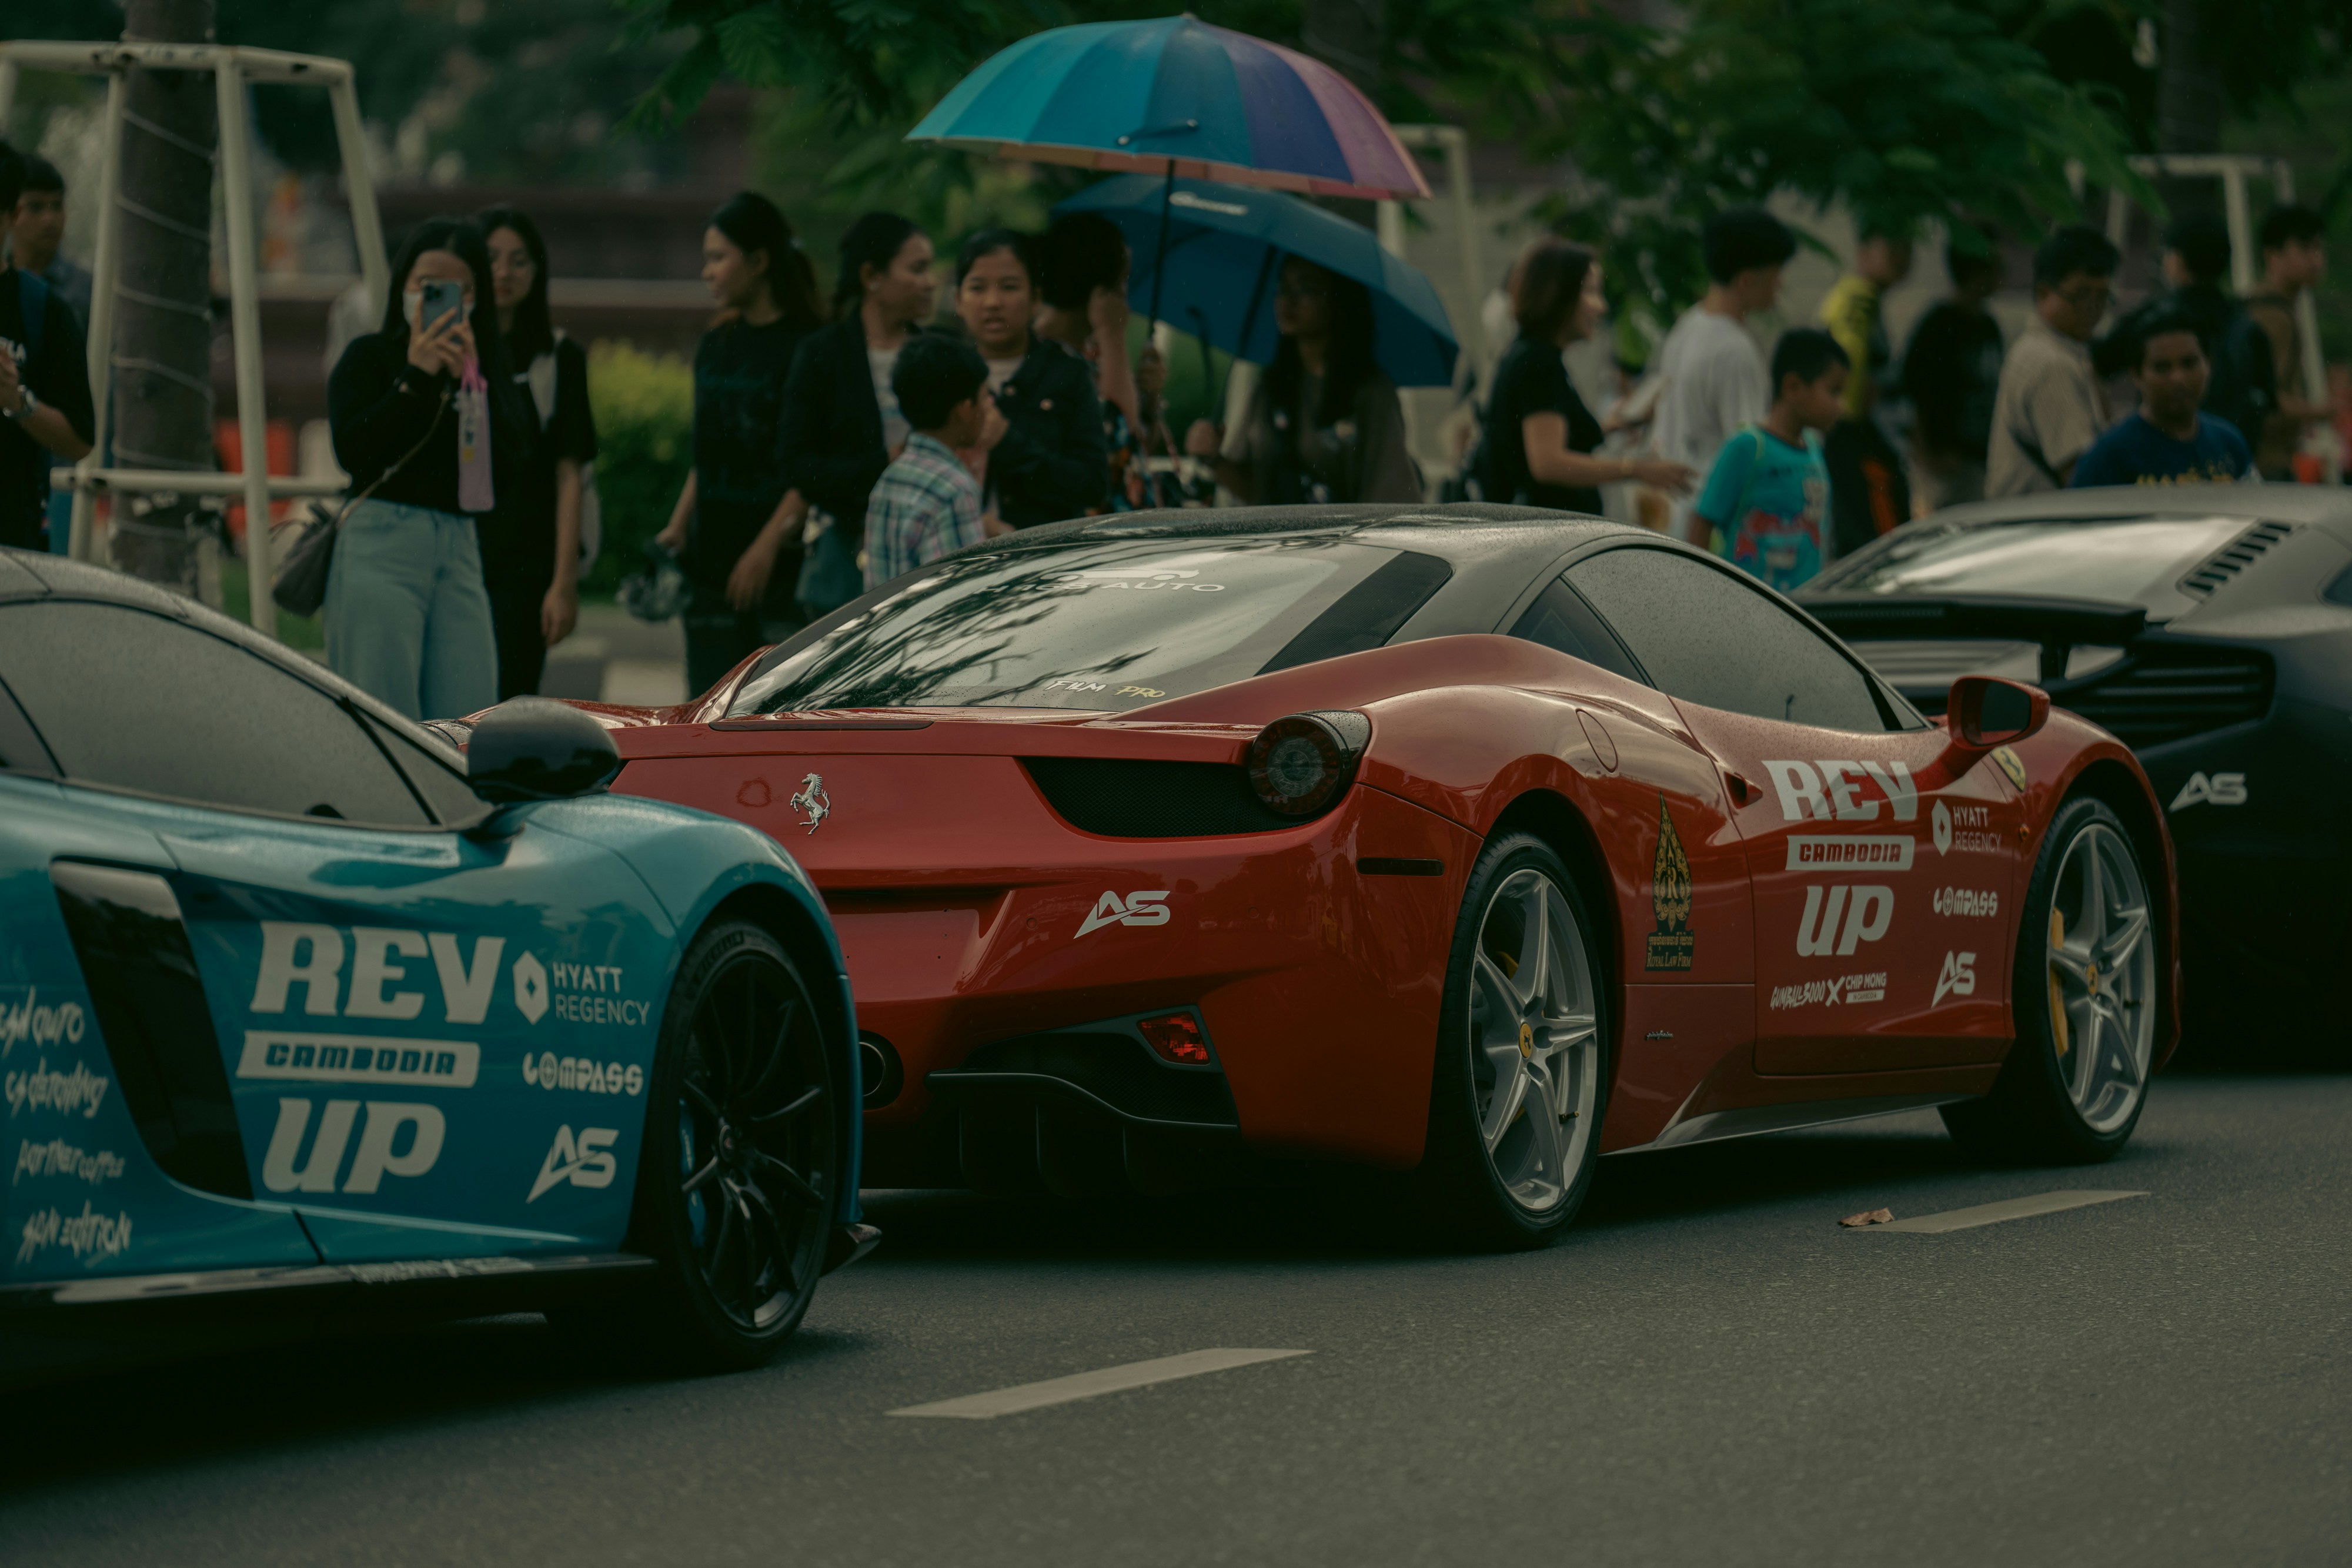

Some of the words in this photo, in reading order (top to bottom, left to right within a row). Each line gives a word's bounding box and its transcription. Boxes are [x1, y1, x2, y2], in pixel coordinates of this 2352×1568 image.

[1098, 582, 1225, 591] AUTO
[1044, 680, 1107, 693] FILM
[1112, 686, 1166, 698] PRO
[1761, 761, 1918, 821] REV
[2168, 770, 2248, 814] AS
[1953, 805, 1989, 828] HYATT
[1799, 844, 1902, 862] CAMBODIA
[1955, 831, 2002, 853] REGENCY
[1073, 890, 1170, 940] AS
[1933, 886, 1998, 917] COMPASS
[1796, 885, 1894, 957] UP
[249, 920, 507, 1025] REV
[553, 962, 622, 994] HYATT
[1845, 974, 1863, 991] CHIP
[1864, 971, 1887, 989] MONG
[1931, 951, 1976, 1008] AS
[555, 994, 650, 1026] REGENCY
[265, 1043, 456, 1075] CAMBODIA
[522, 1051, 644, 1096] COMPASS
[262, 1098, 446, 1194] UP
[526, 1124, 620, 1204] AS
